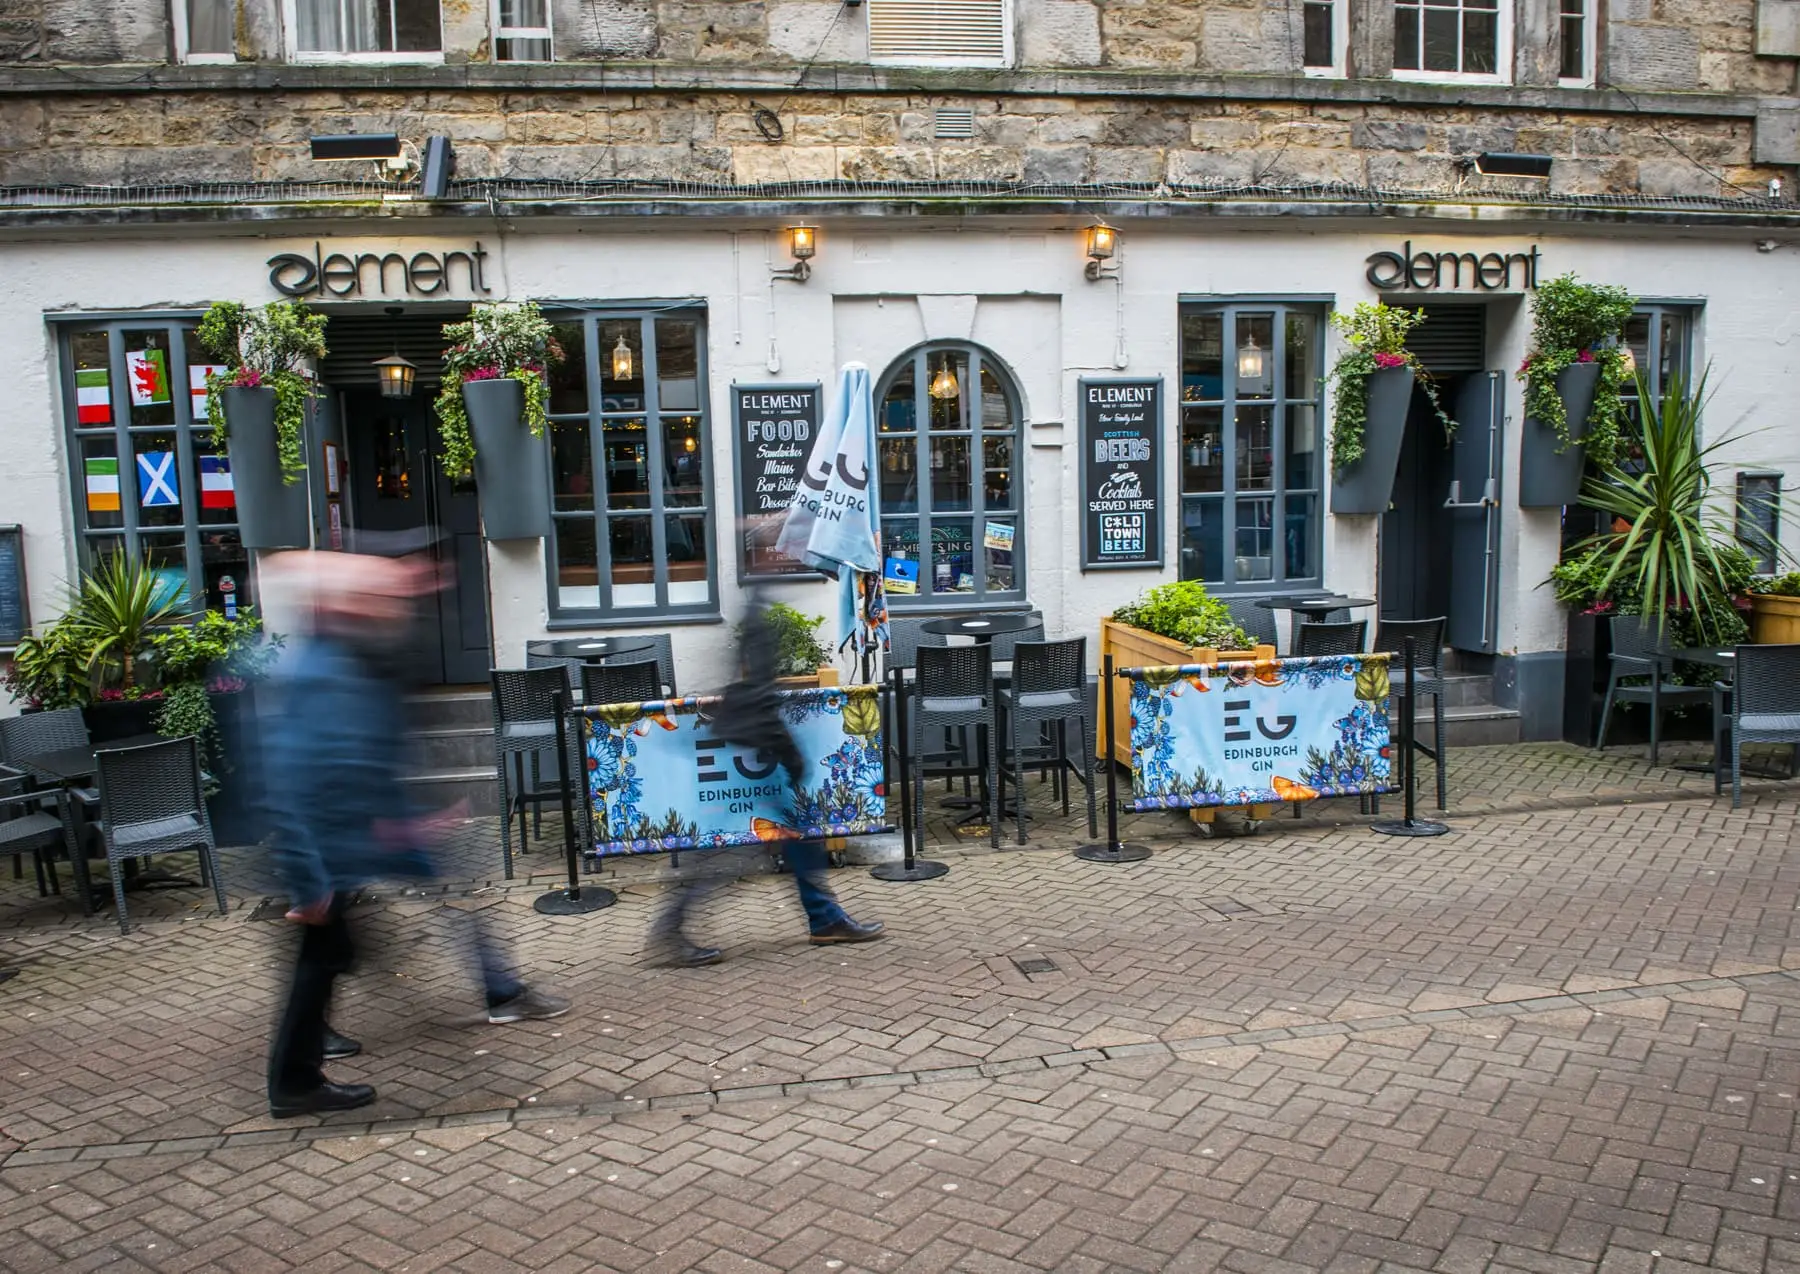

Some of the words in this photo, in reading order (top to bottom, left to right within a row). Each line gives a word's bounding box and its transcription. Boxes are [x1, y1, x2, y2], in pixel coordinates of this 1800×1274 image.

[266, 241, 491, 295] element
[1366, 240, 1542, 289] element
[742, 394, 811, 409] ELEMENT
[1089, 388, 1154, 403] ELEMENT
[747, 420, 809, 442] FOOD
[756, 443, 802, 458] Sandwiches
[1095, 438, 1150, 463] BEERS
[764, 460, 795, 474] Mains
[756, 477, 776, 492] Bar
[1098, 482, 1143, 500] Cocktails
[1089, 501, 1127, 512] SERVED
[1130, 500, 1154, 511] HERE
[1104, 528, 1141, 539] TOWN
[1104, 539, 1141, 551] BEER
[1224, 745, 1298, 760] EDINBURGH
[1252, 761, 1273, 772] GIN
[699, 784, 782, 802] EDINBURGH
[729, 802, 754, 814] GIN
